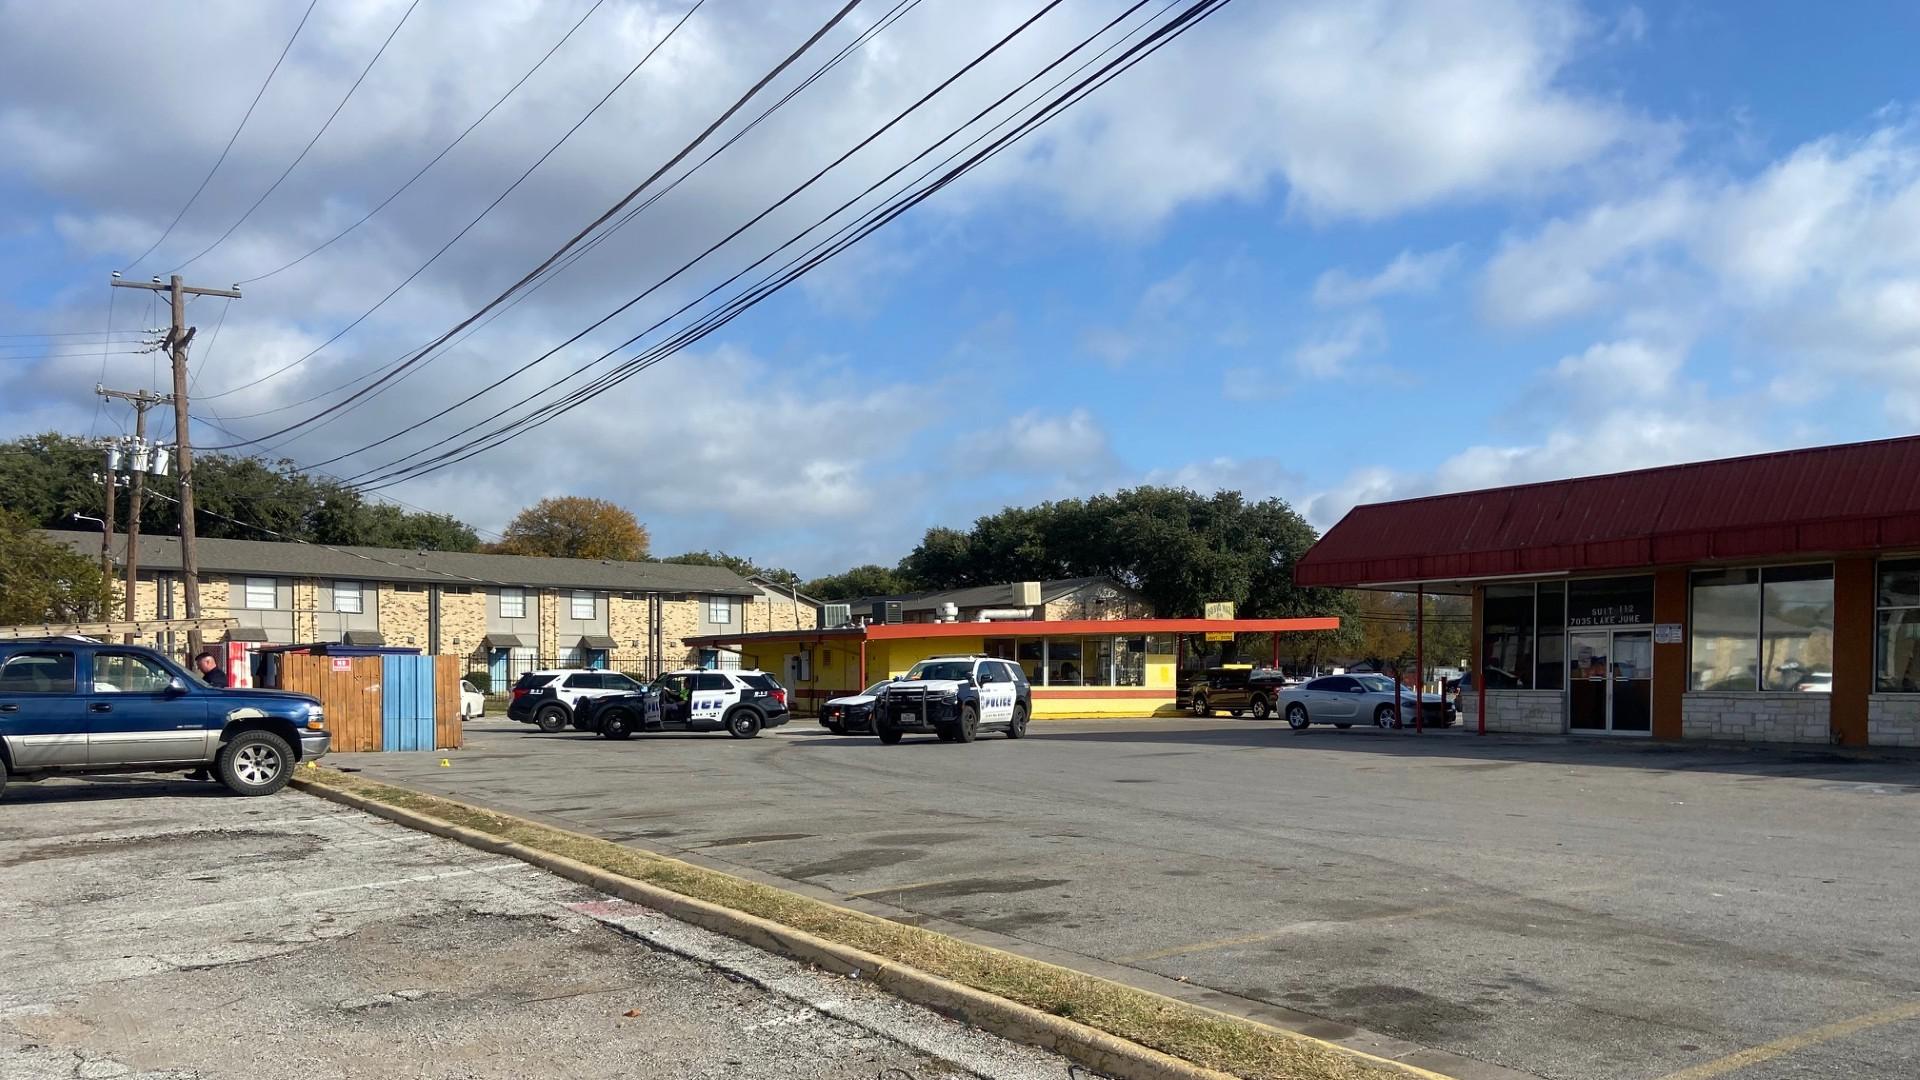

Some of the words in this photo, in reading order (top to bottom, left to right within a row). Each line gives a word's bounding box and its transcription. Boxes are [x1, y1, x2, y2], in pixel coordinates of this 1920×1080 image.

[1592, 608, 1612, 616] SUIT
[1594, 616, 1615, 624] LAKE
[1618, 615, 1640, 623] JUNE
[985, 697, 1011, 708] POLICE
